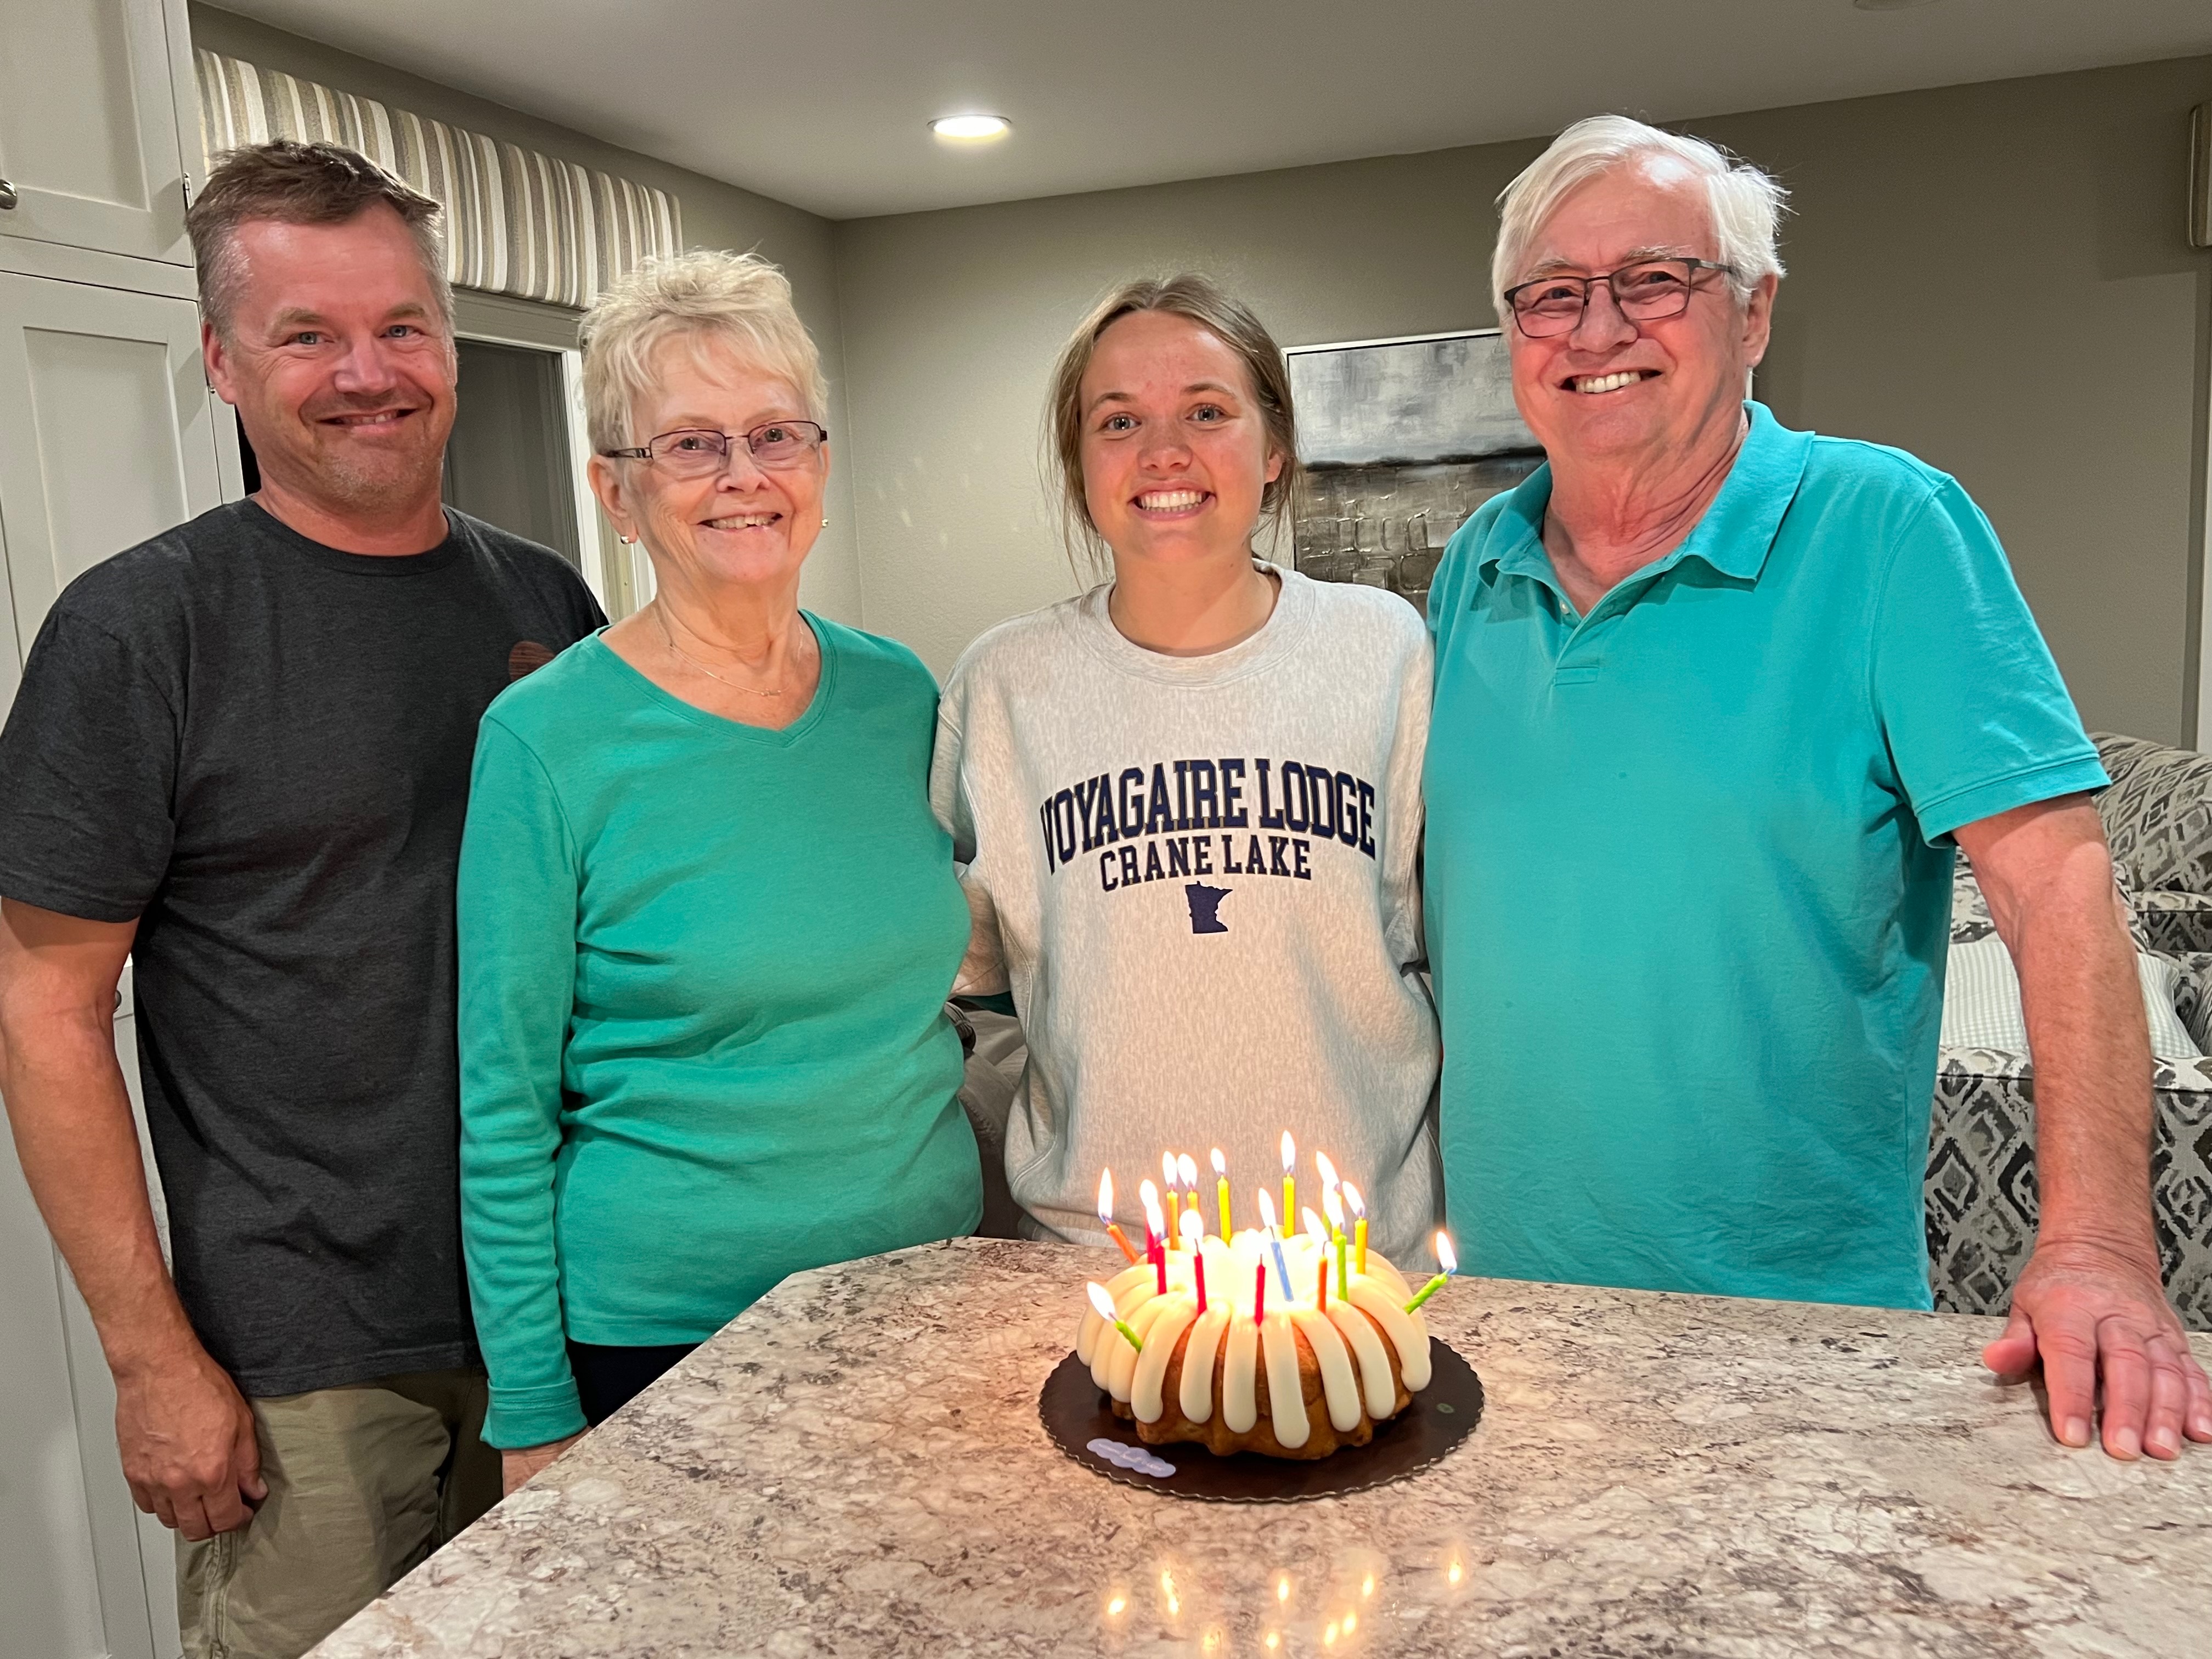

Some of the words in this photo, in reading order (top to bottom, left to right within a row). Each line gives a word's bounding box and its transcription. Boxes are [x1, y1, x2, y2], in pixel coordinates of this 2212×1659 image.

[1040, 759, 1249, 876] VOYAGAIRE
[1254, 758, 1376, 861] LODGE
[1099, 836, 1214, 893] CRANE
[1221, 834, 1312, 881] LAKE
